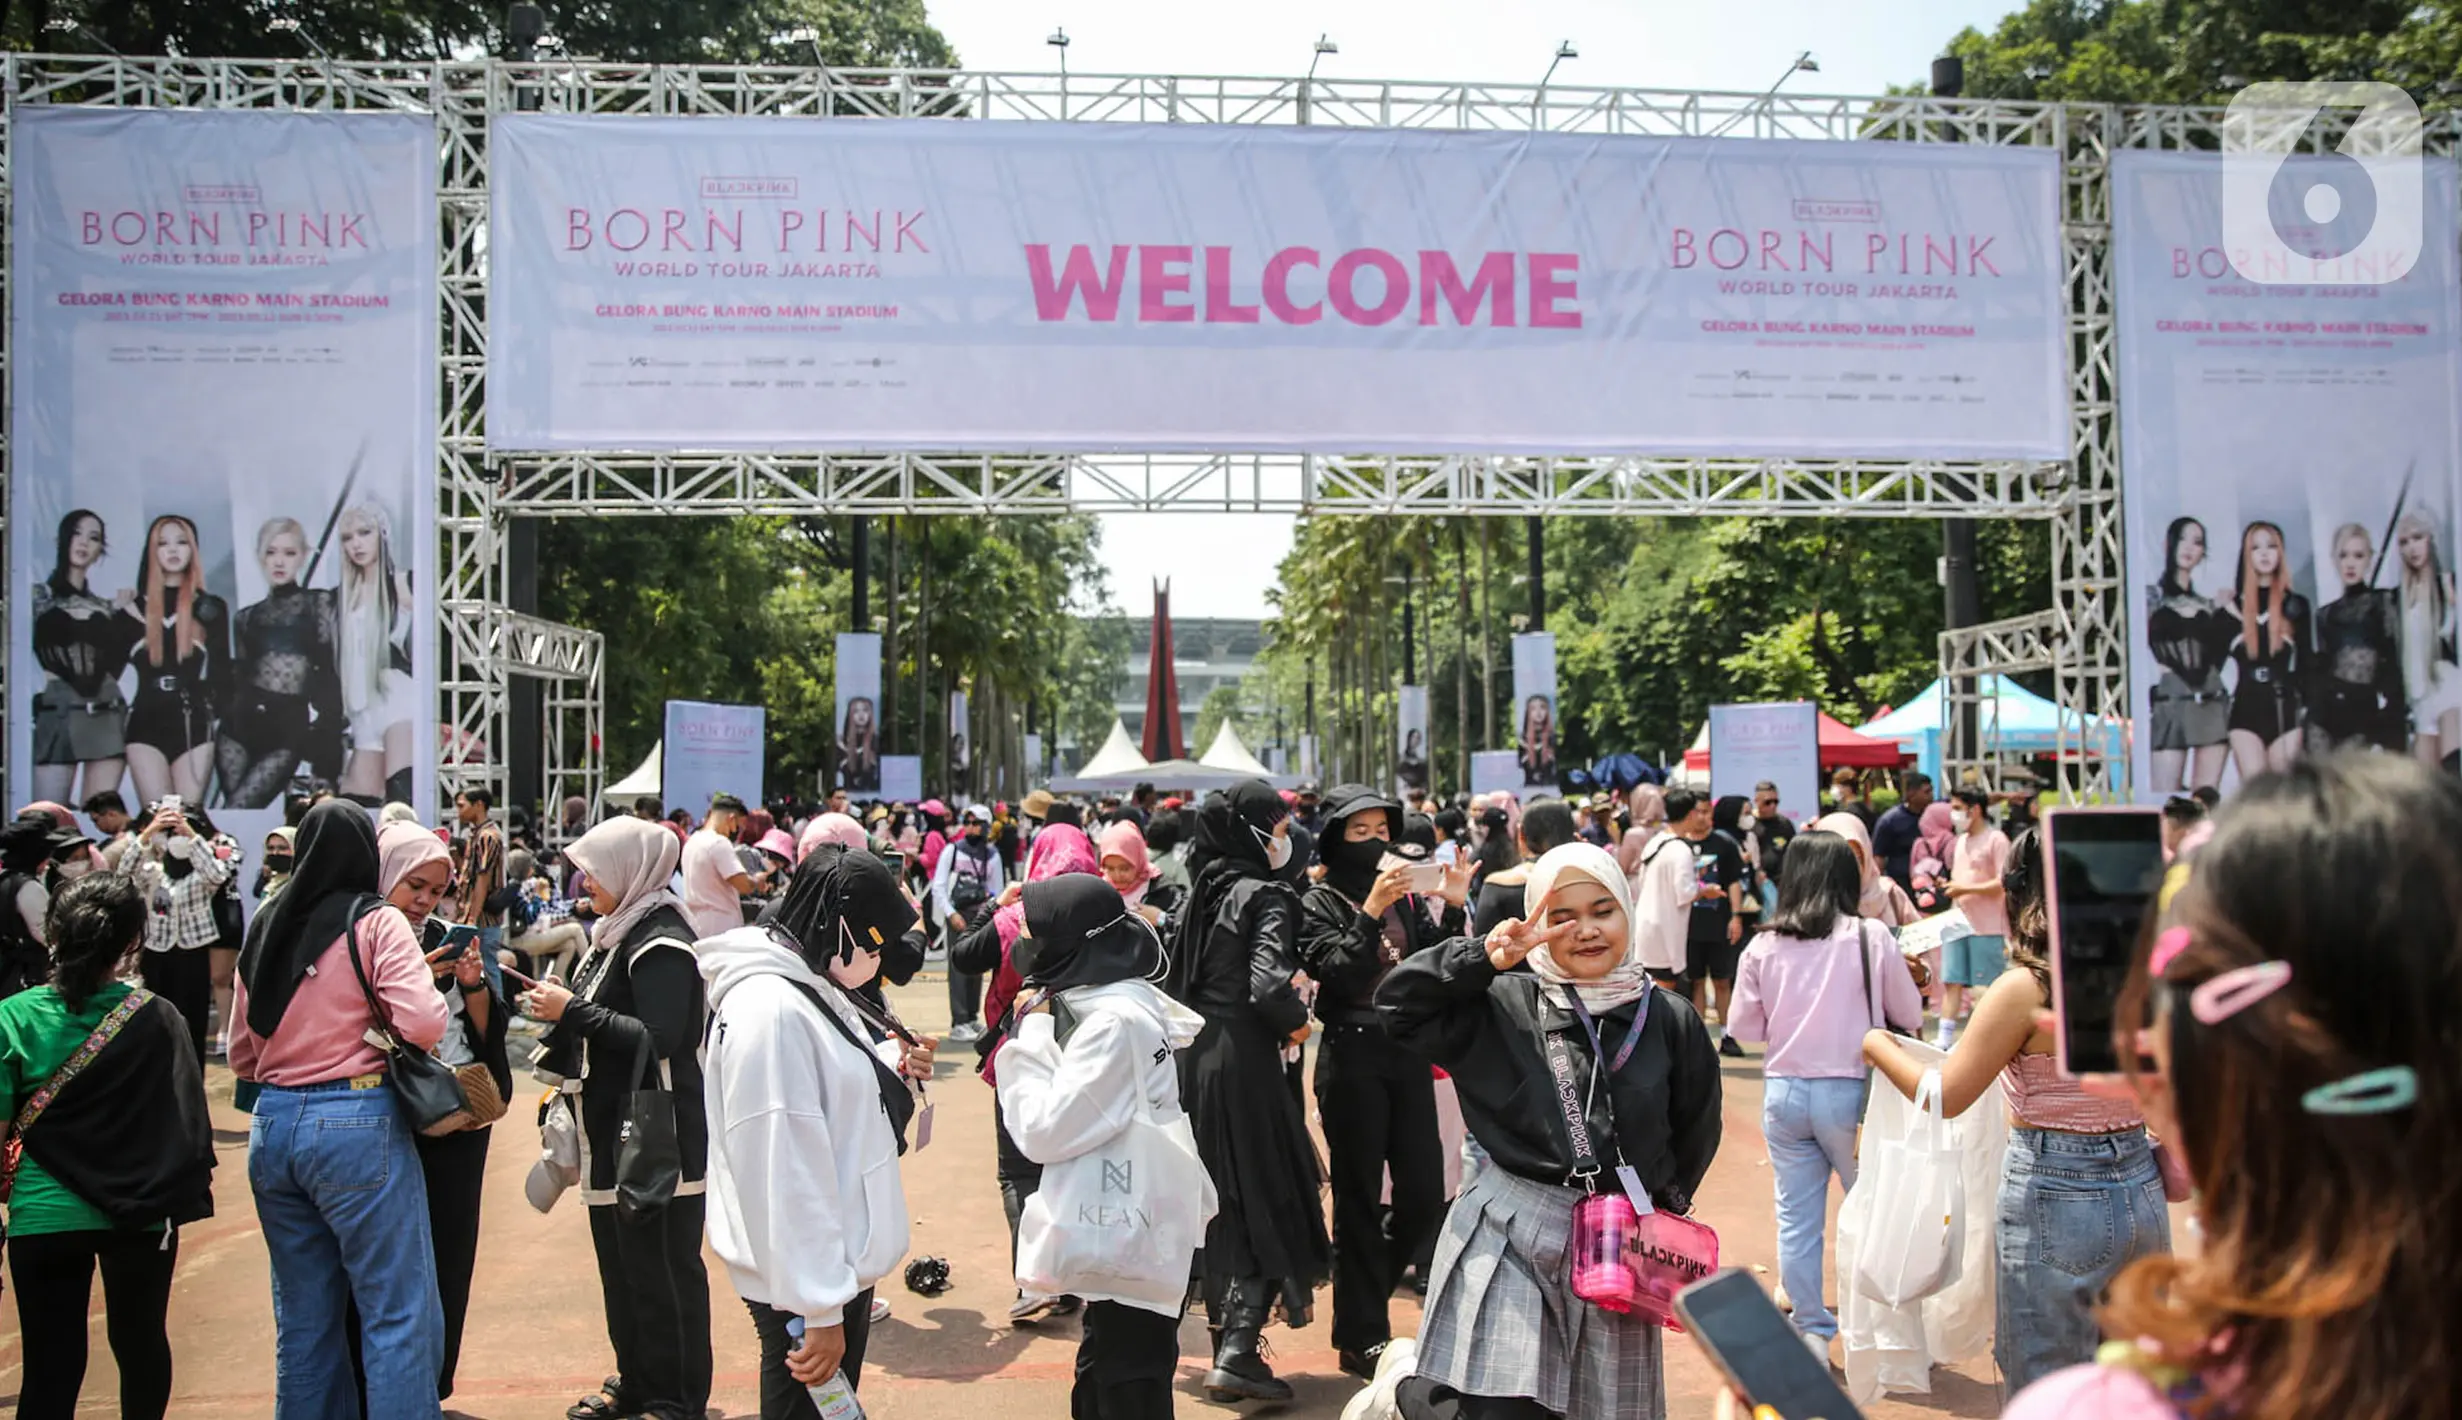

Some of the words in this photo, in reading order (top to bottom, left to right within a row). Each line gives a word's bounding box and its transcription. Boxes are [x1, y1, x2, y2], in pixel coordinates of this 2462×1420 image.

[83, 211, 220, 246] BORN
[249, 211, 368, 248] PINK
[566, 208, 742, 252] BORN
[779, 208, 930, 253] PINK
[120, 253, 185, 266] WORLD
[194, 253, 241, 266] TOUR
[250, 253, 329, 267] JAKARTA
[1671, 227, 1833, 273] BORN
[1867, 231, 2000, 278] PINK
[2172, 247, 2288, 281] BORN
[2311, 247, 2409, 282] PINK
[615, 262, 699, 278] WORLD
[708, 262, 769, 278] TOUR
[778, 263, 881, 279] JAKARTA
[1023, 243, 1582, 329] WELCOME
[58, 292, 126, 307] GELORA
[132, 292, 181, 307] BUNG
[186, 292, 250, 308] KARNO
[255, 293, 304, 308] MAIN
[309, 294, 389, 308] STADIUM
[1719, 280, 1795, 296] WORLD
[1803, 281, 1858, 297] TOUR
[1867, 284, 1958, 300] JAKARTA
[595, 304, 658, 318] GELORA
[663, 304, 708, 318] BUNG
[713, 304, 772, 318] KARNO
[777, 304, 821, 318] MAIN
[826, 304, 899, 319] STADIUM
[1701, 320, 1760, 333] GELORA
[1764, 320, 1806, 334] BUNG
[1810, 322, 1863, 335] KARNO
[1867, 322, 1906, 336] MAIN
[1911, 324, 1976, 338] STADIUM
[1552, 1055, 1592, 1159] BLACKPINK
[1630, 1237, 1707, 1277] BLACKPINK
